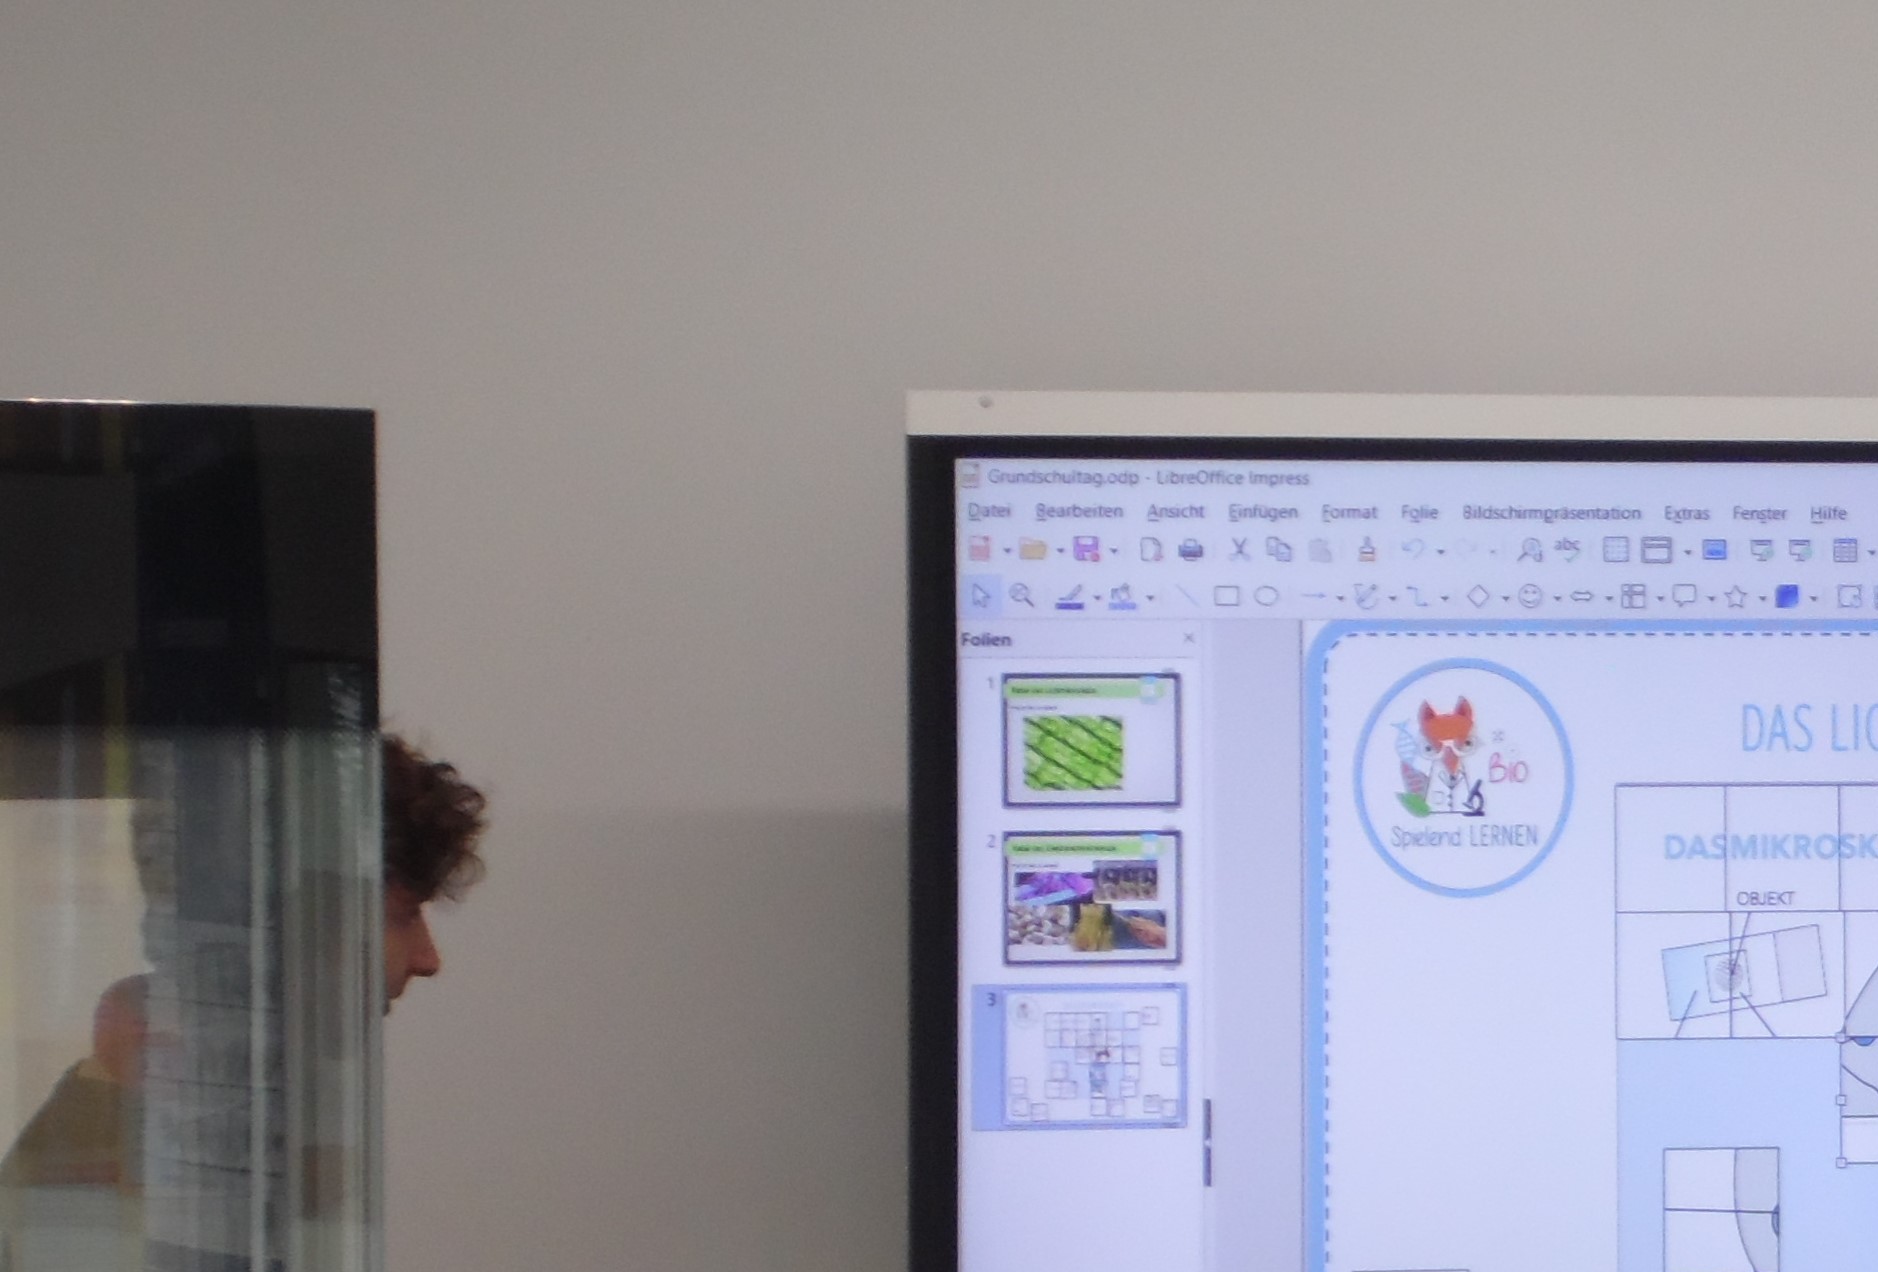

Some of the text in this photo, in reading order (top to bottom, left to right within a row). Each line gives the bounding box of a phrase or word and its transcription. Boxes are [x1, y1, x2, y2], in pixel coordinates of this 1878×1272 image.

[987, 469, 1139, 487] Grundschultag.odp
[1156, 470, 1244, 485] LibreOffice
[1249, 470, 1310, 487] Impress
[968, 503, 1847, 522] Datei Bearbeiten Ansicht Einfügen Format Folie Bildschirmpräsentation Extras Fenster Hilfe
[961, 633, 1012, 647] Folien
[1742, 703, 1813, 752] DAS
[987, 835, 996, 848] 2
[1391, 824, 1539, 848] Spielend LERNEN
[1737, 891, 1795, 905] OBJEKT
[987, 993, 996, 1006] 3
